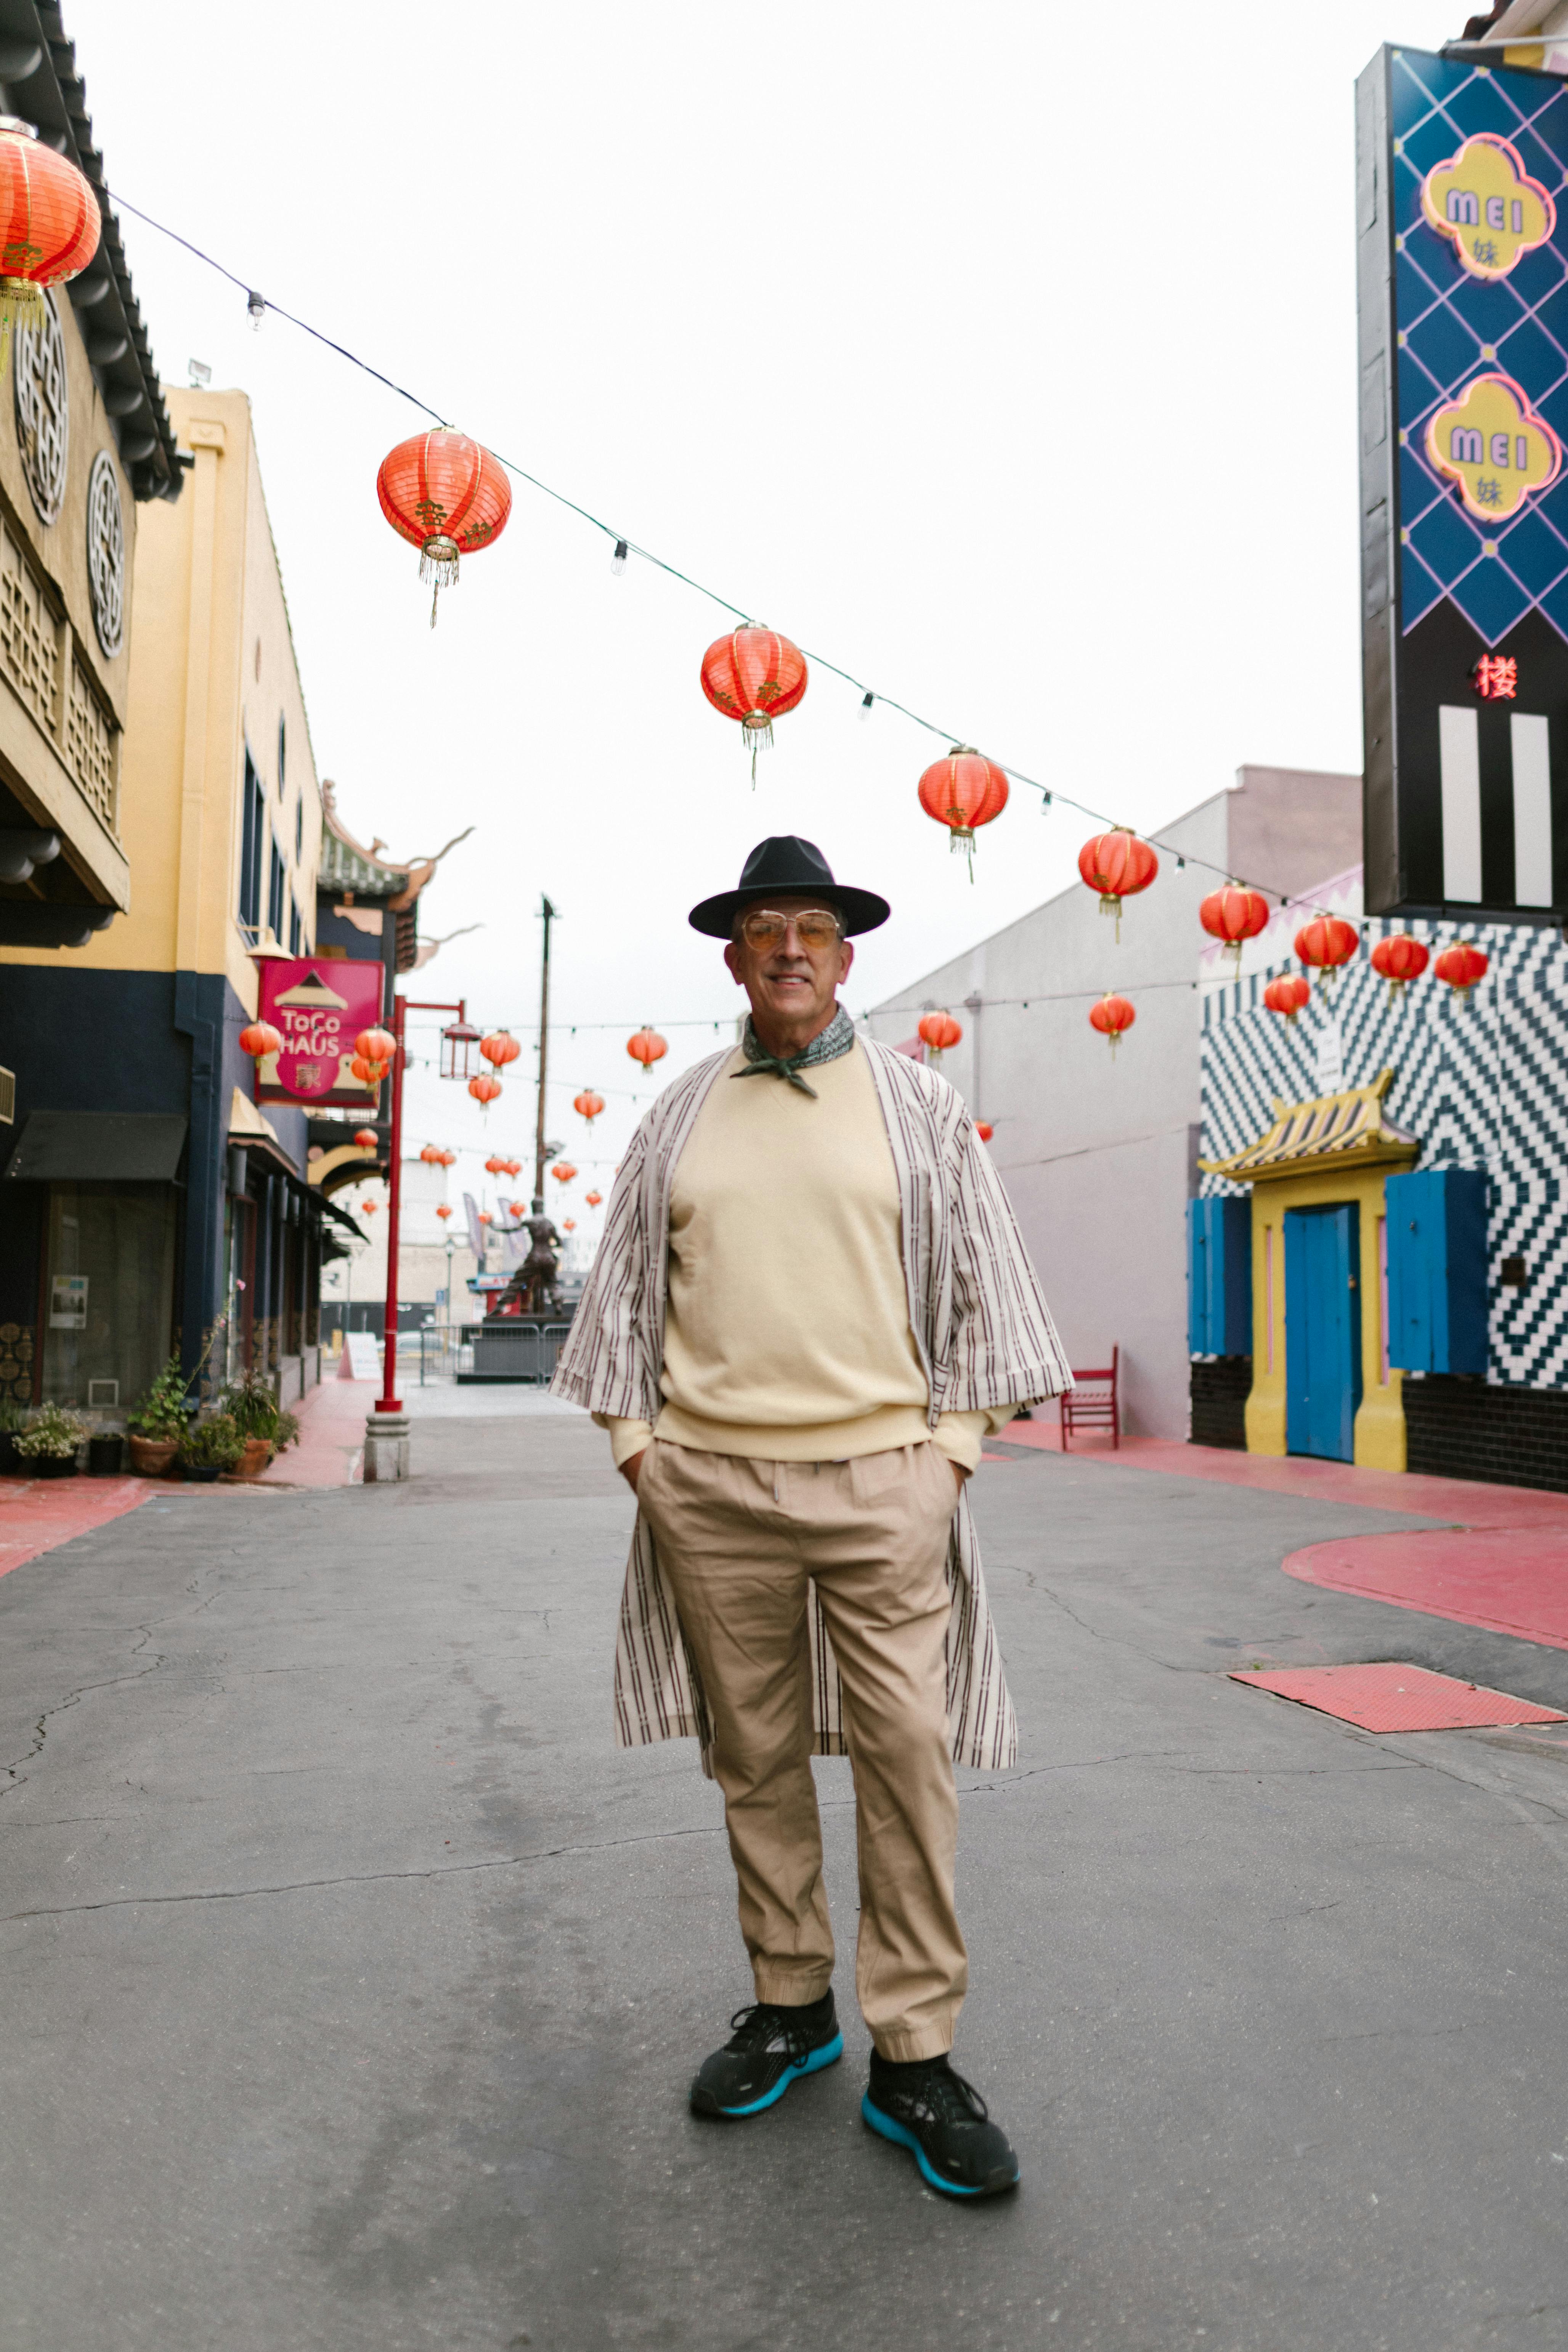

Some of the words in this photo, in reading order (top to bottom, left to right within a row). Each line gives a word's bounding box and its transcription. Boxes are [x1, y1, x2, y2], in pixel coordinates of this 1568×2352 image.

[1447, 188, 1521, 233] MEI
[1451, 426, 1526, 470] MEI
[1478, 653, 1518, 698] 楼
[280, 1030, 339, 1057] HAUS
